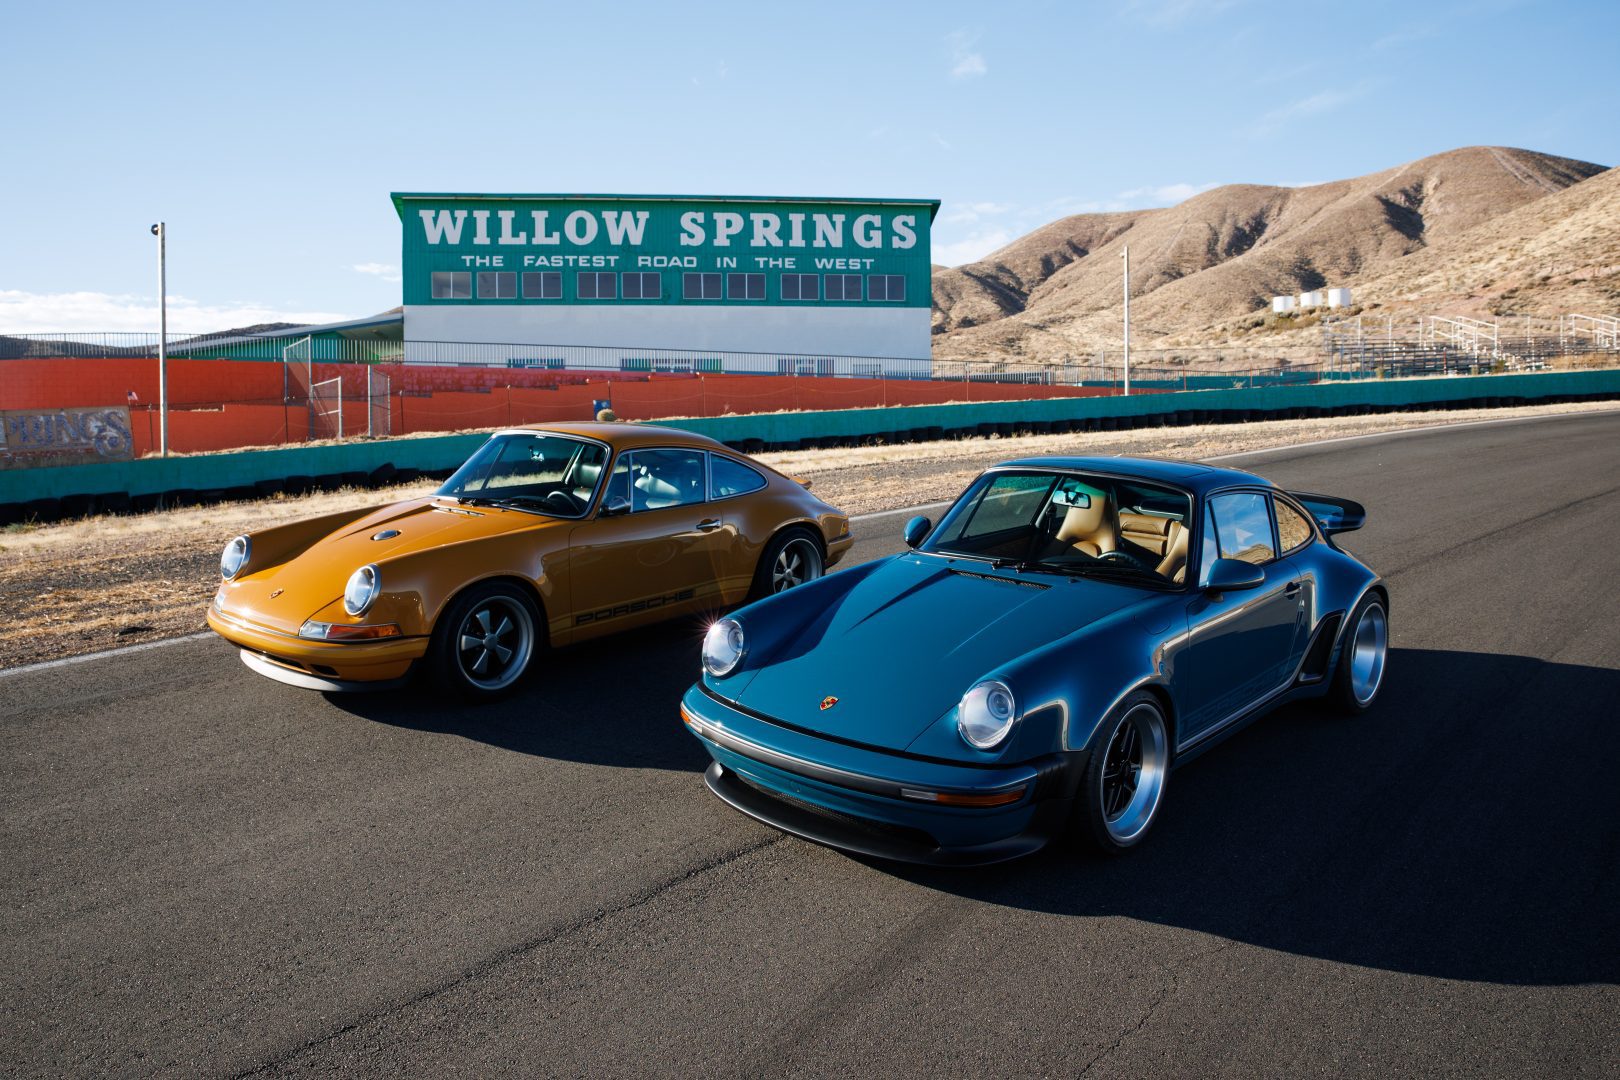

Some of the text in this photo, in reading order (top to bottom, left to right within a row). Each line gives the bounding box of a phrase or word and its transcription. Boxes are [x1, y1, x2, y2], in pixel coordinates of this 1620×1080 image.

[419, 209, 917, 249] WILLOW SPRINGS
[461, 255, 874, 270] THE FASTEST ROAD IN THE WEST
[576, 588, 694, 625] PORSCHE
